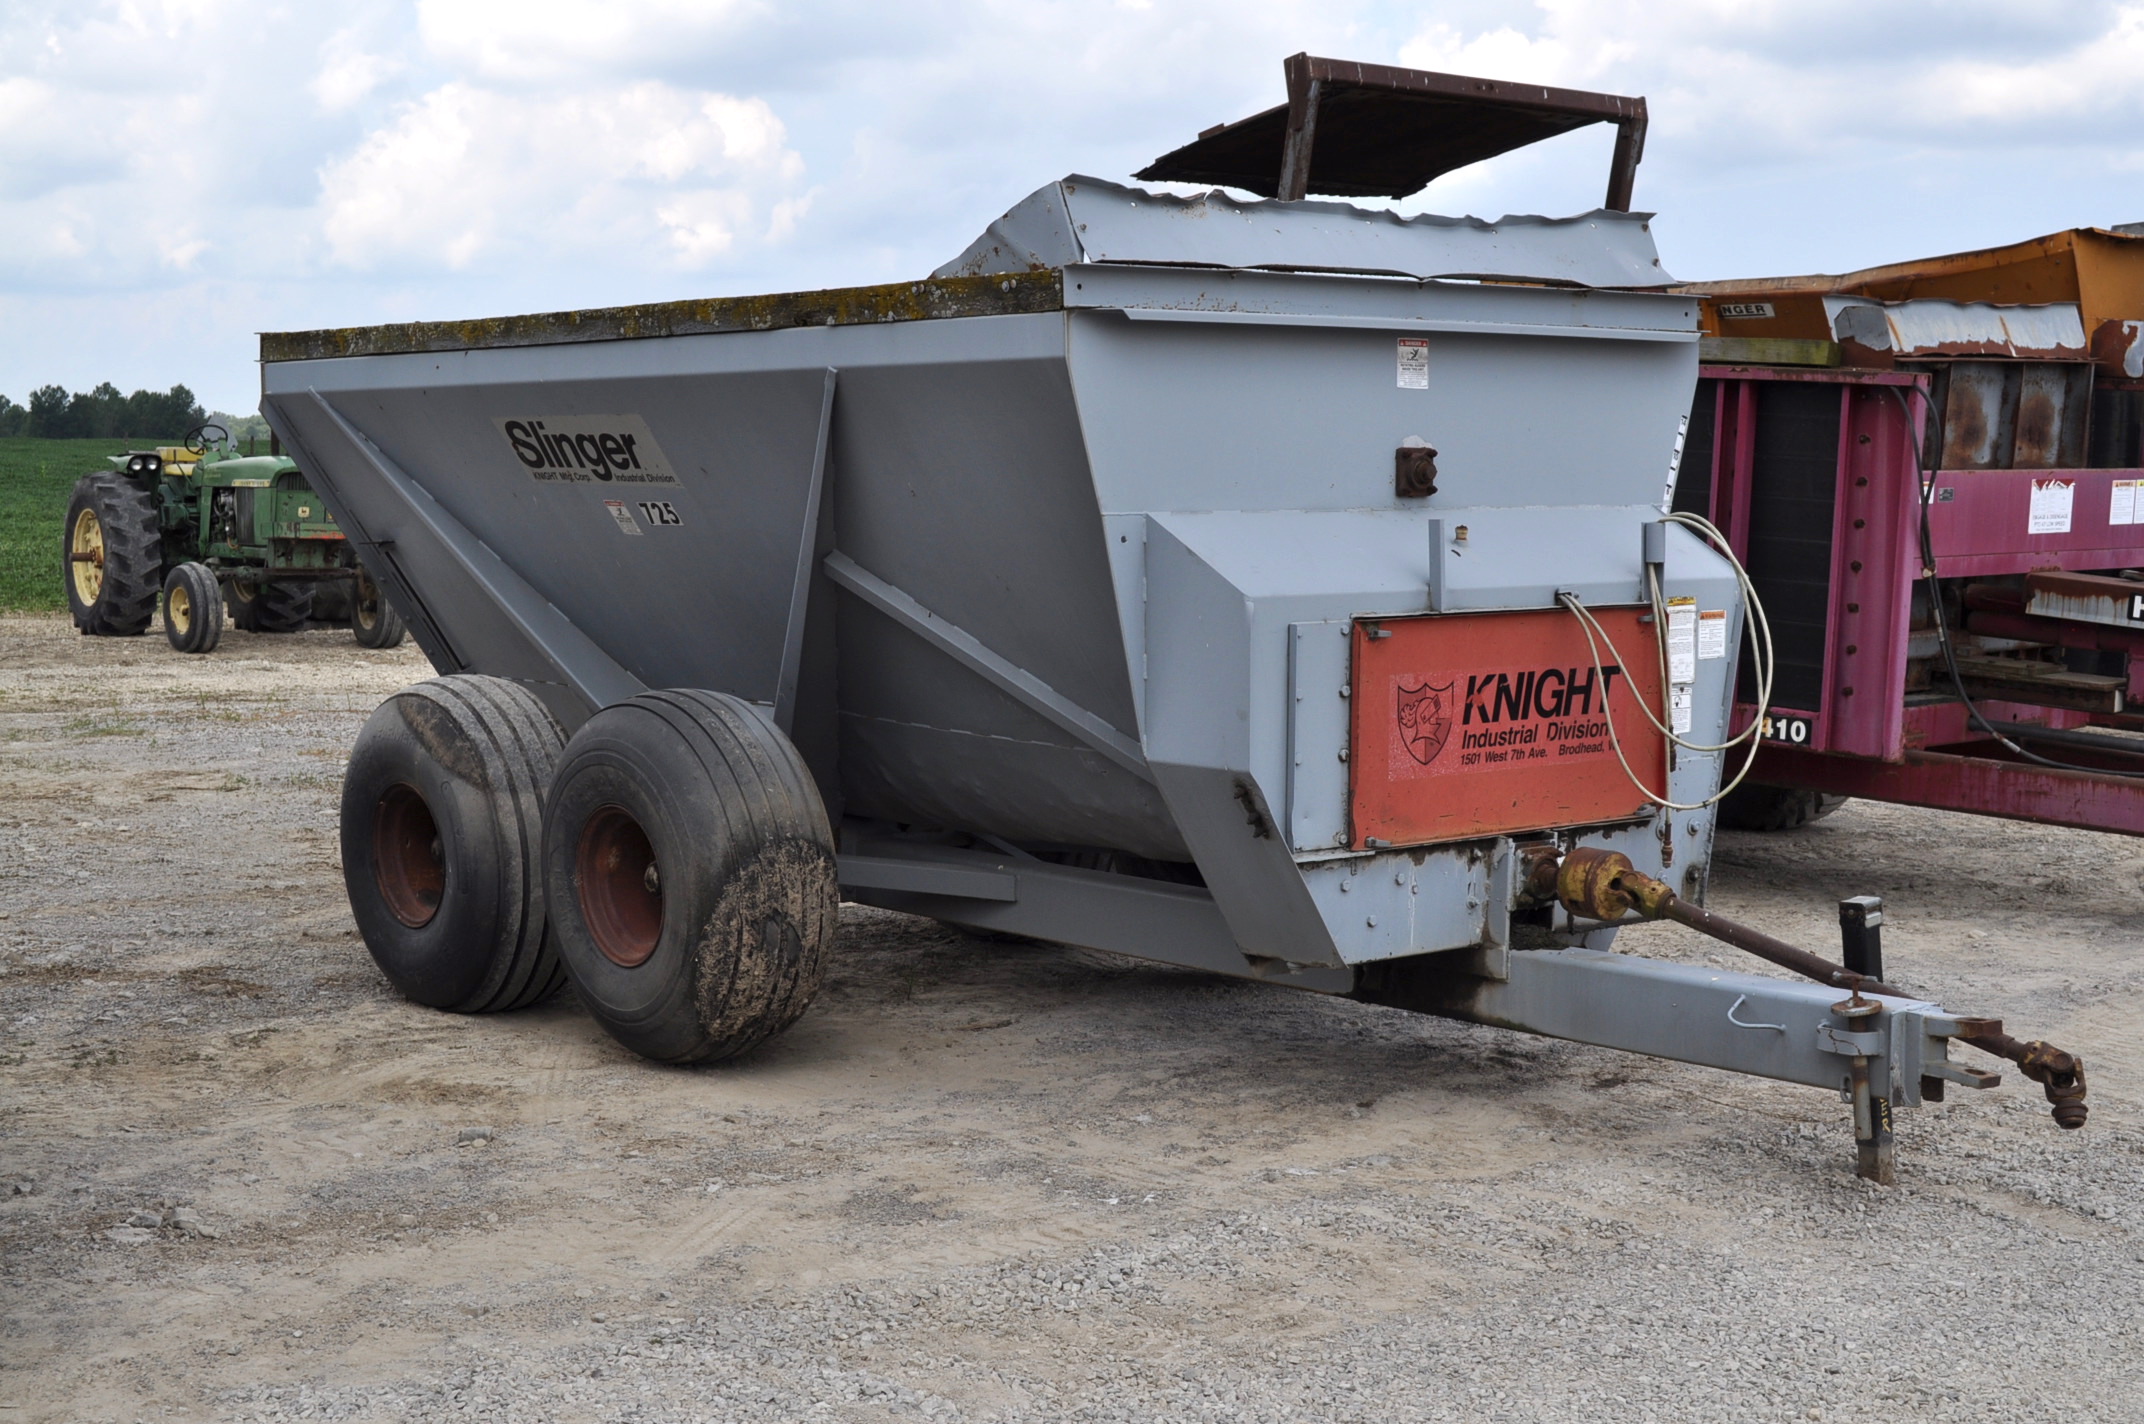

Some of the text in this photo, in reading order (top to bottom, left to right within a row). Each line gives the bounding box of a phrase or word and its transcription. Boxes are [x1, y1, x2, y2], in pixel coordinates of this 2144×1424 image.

[1721, 304, 1767, 316] NGER
[505, 420, 641, 481] Slinger
[533, 472, 558, 481] KNIGHT
[615, 474, 646, 482] Industrial
[647, 474, 675, 483] Division
[638, 502, 681, 525] 725
[1462, 666, 1621, 725] KNIGHT
[1462, 719, 1609, 750] Industrial Division
[1762, 716, 1806, 743] 410
[1461, 753, 1481, 766] 1501
[1485, 750, 1508, 763] West
[1511, 749, 1525, 761] 7th
[1528, 747, 1548, 759] Ave.
[1558, 741, 1605, 756] Brodhead,
